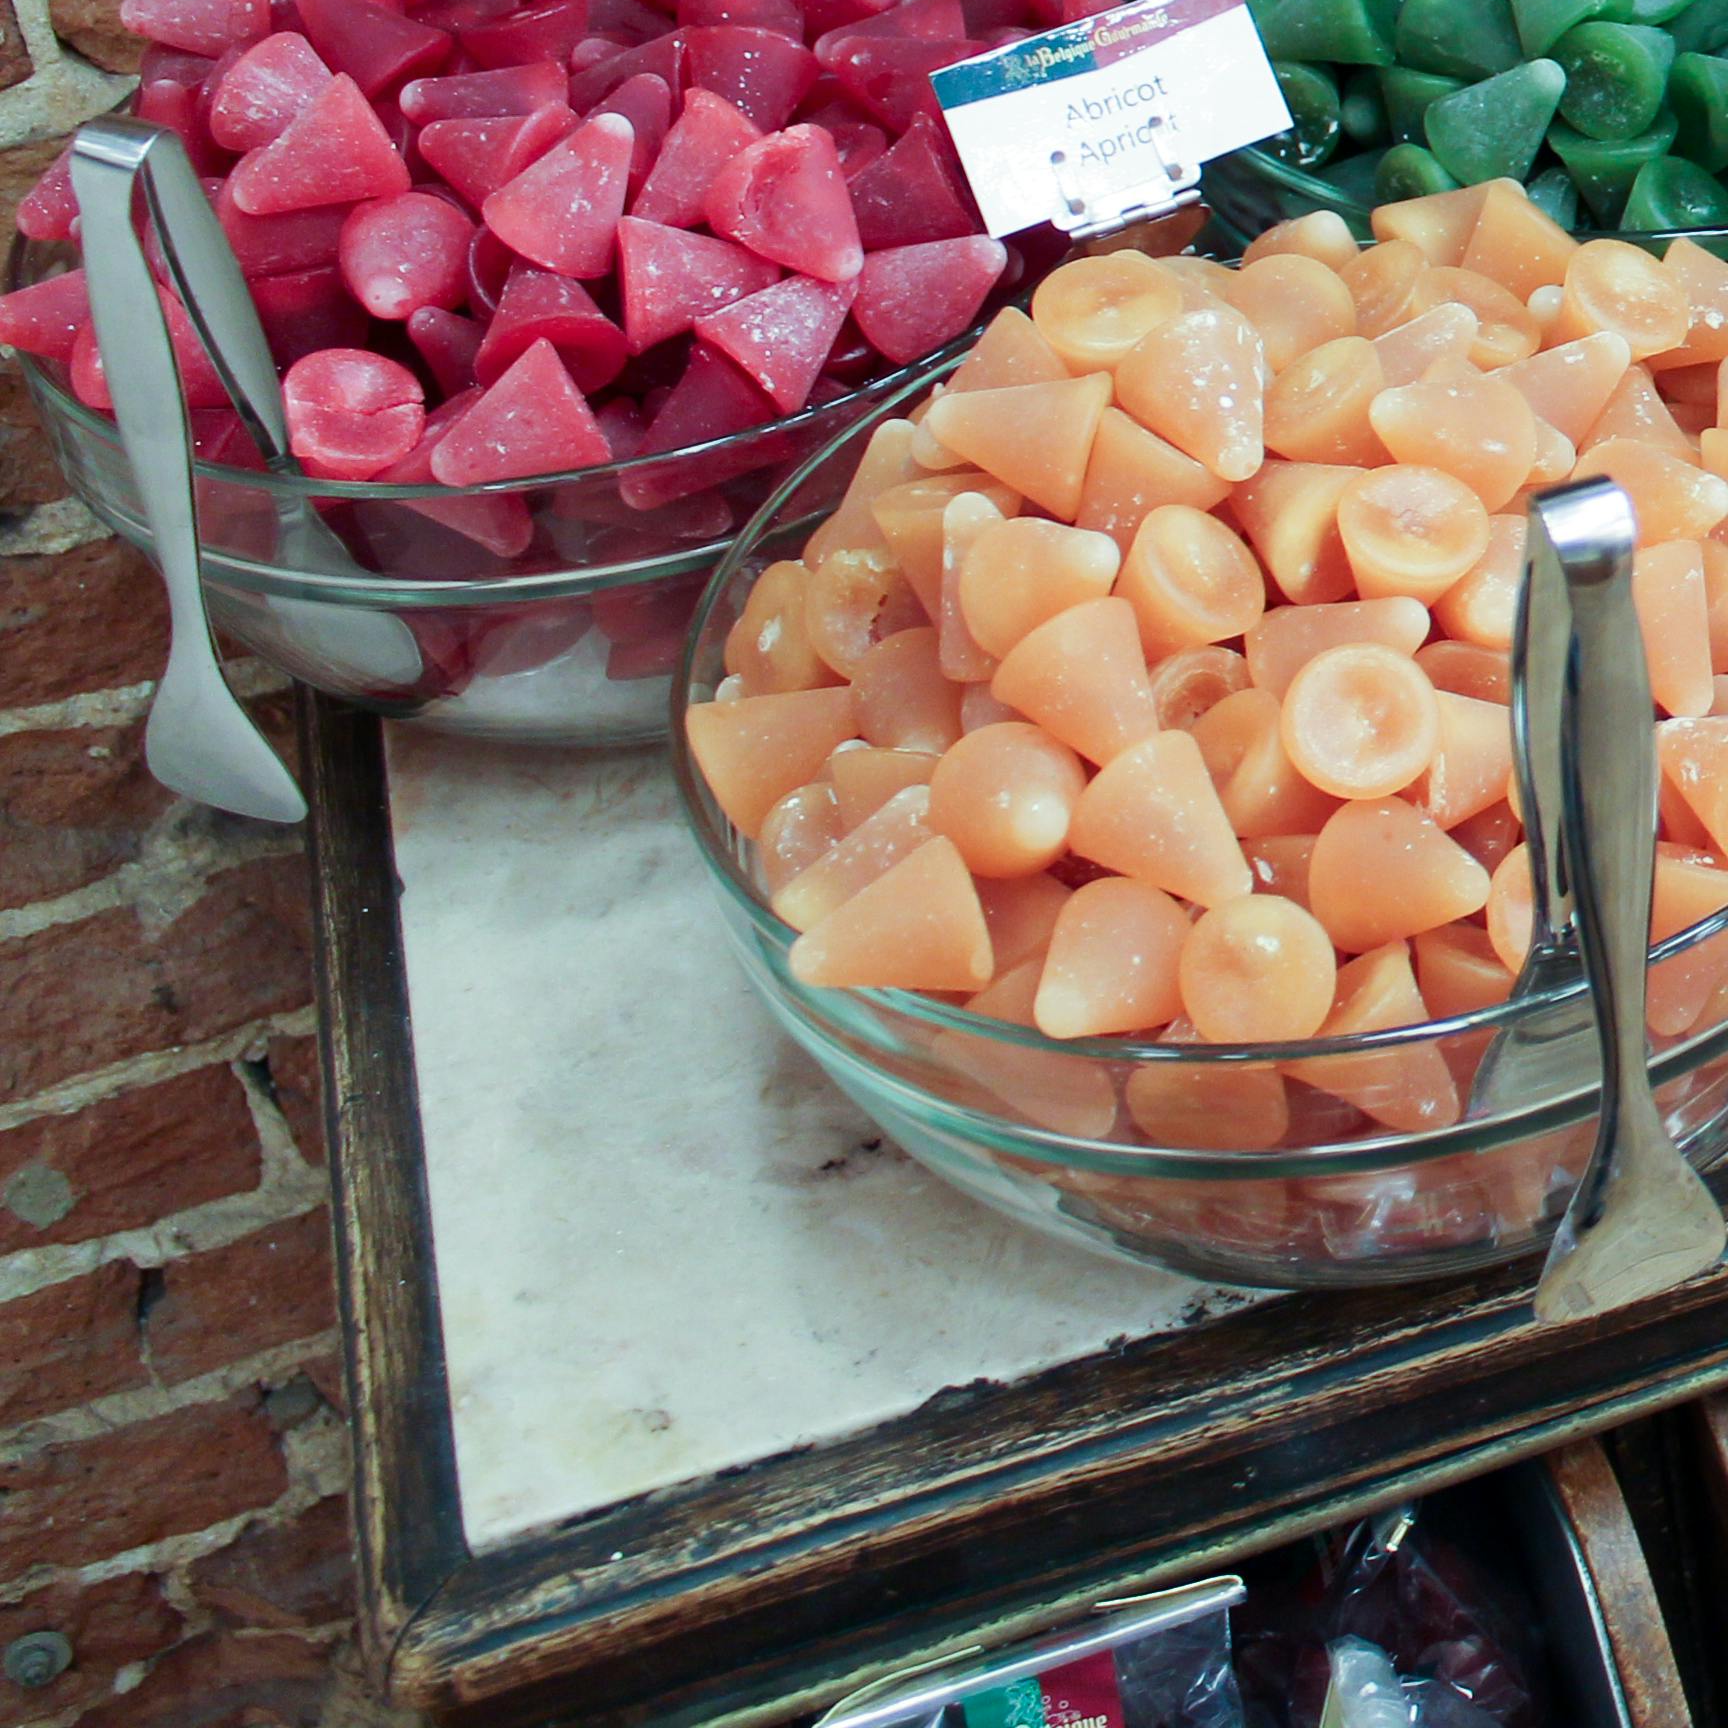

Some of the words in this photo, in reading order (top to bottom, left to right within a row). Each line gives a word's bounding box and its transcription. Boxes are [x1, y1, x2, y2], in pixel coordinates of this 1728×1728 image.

[1037, 39, 1095, 71] Belgique
[1067, 76, 1168, 129] Abricot
[1081, 114, 1180, 167] Aprict
